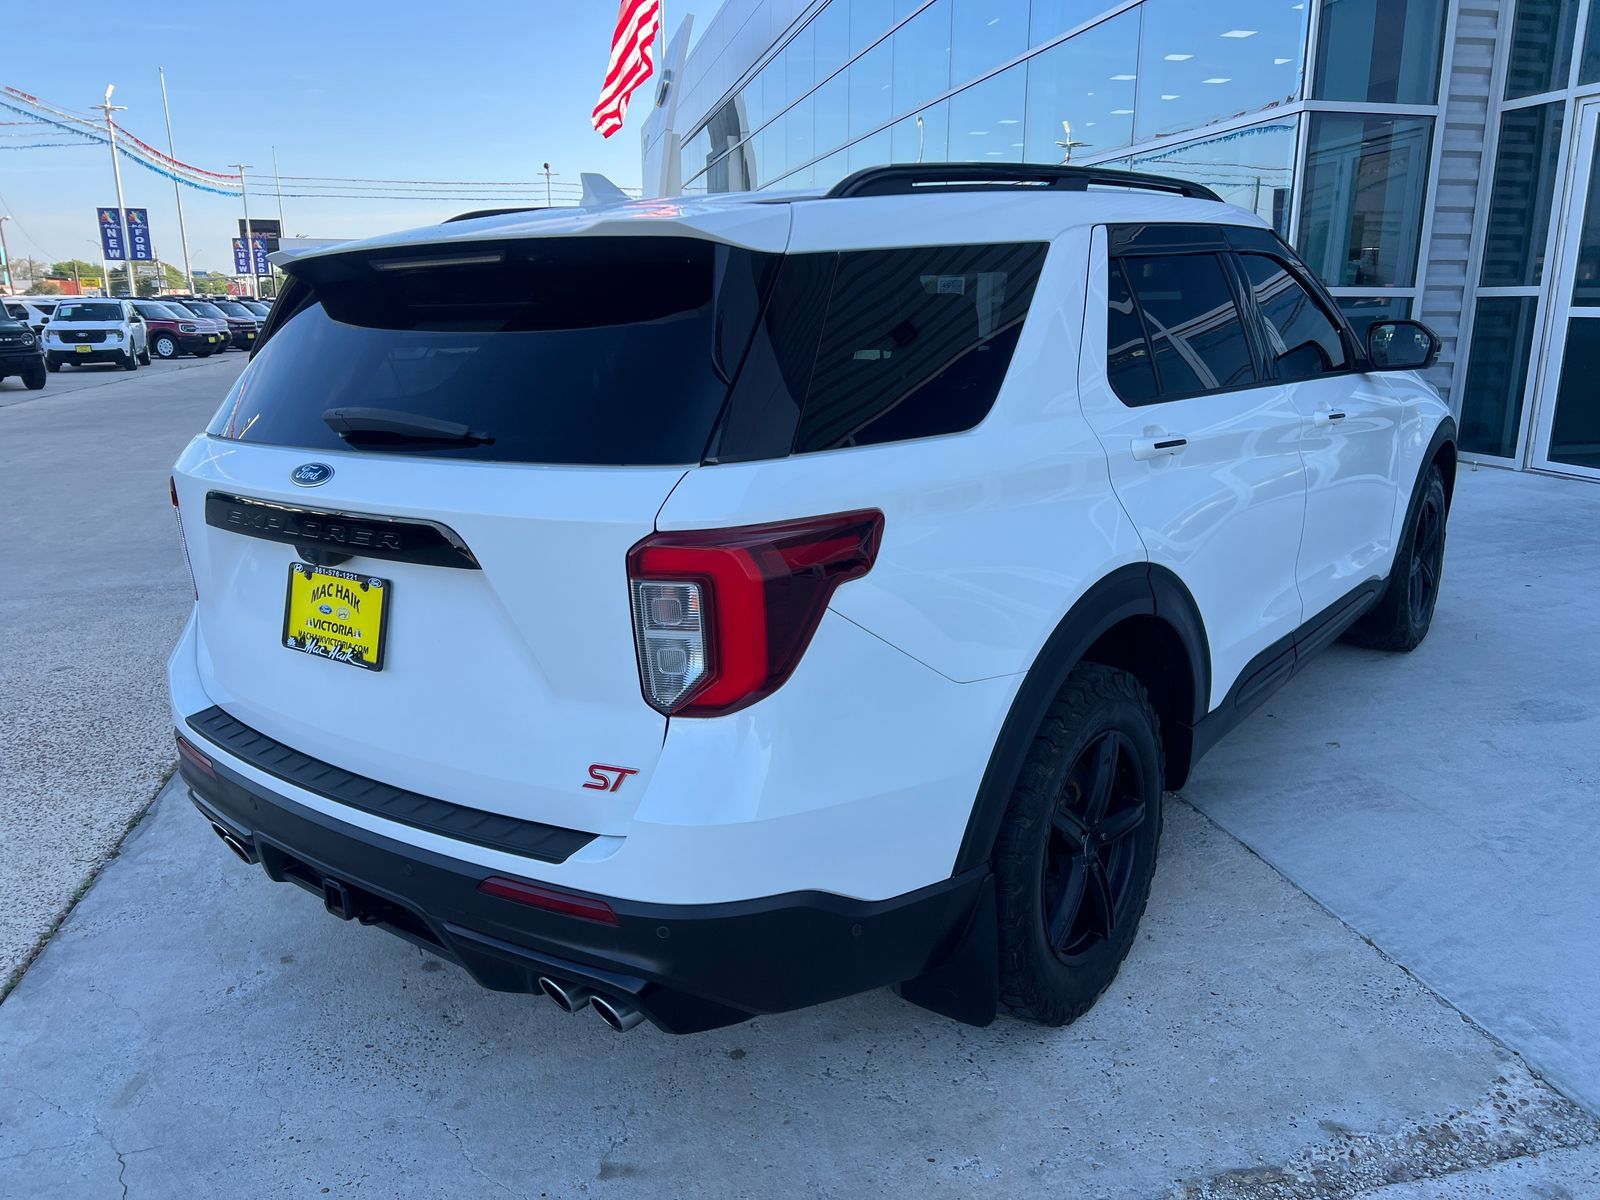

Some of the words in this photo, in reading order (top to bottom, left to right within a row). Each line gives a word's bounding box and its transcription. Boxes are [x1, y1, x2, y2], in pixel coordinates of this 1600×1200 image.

[106, 229, 120, 258] NEW
[134, 229, 146, 258] FORD
[237, 252, 248, 273] NEW
[257, 252, 265, 273] FORD
[296, 465, 321, 481] Ford
[227, 510, 401, 550] EXPLORER
[311, 583, 333, 603] MAC
[335, 584, 361, 613] HAIK
[313, 618, 353, 637] VICTORIA
[305, 638, 327, 655] Mac
[328, 645, 355, 662] Haik
[582, 762, 640, 792] ST
